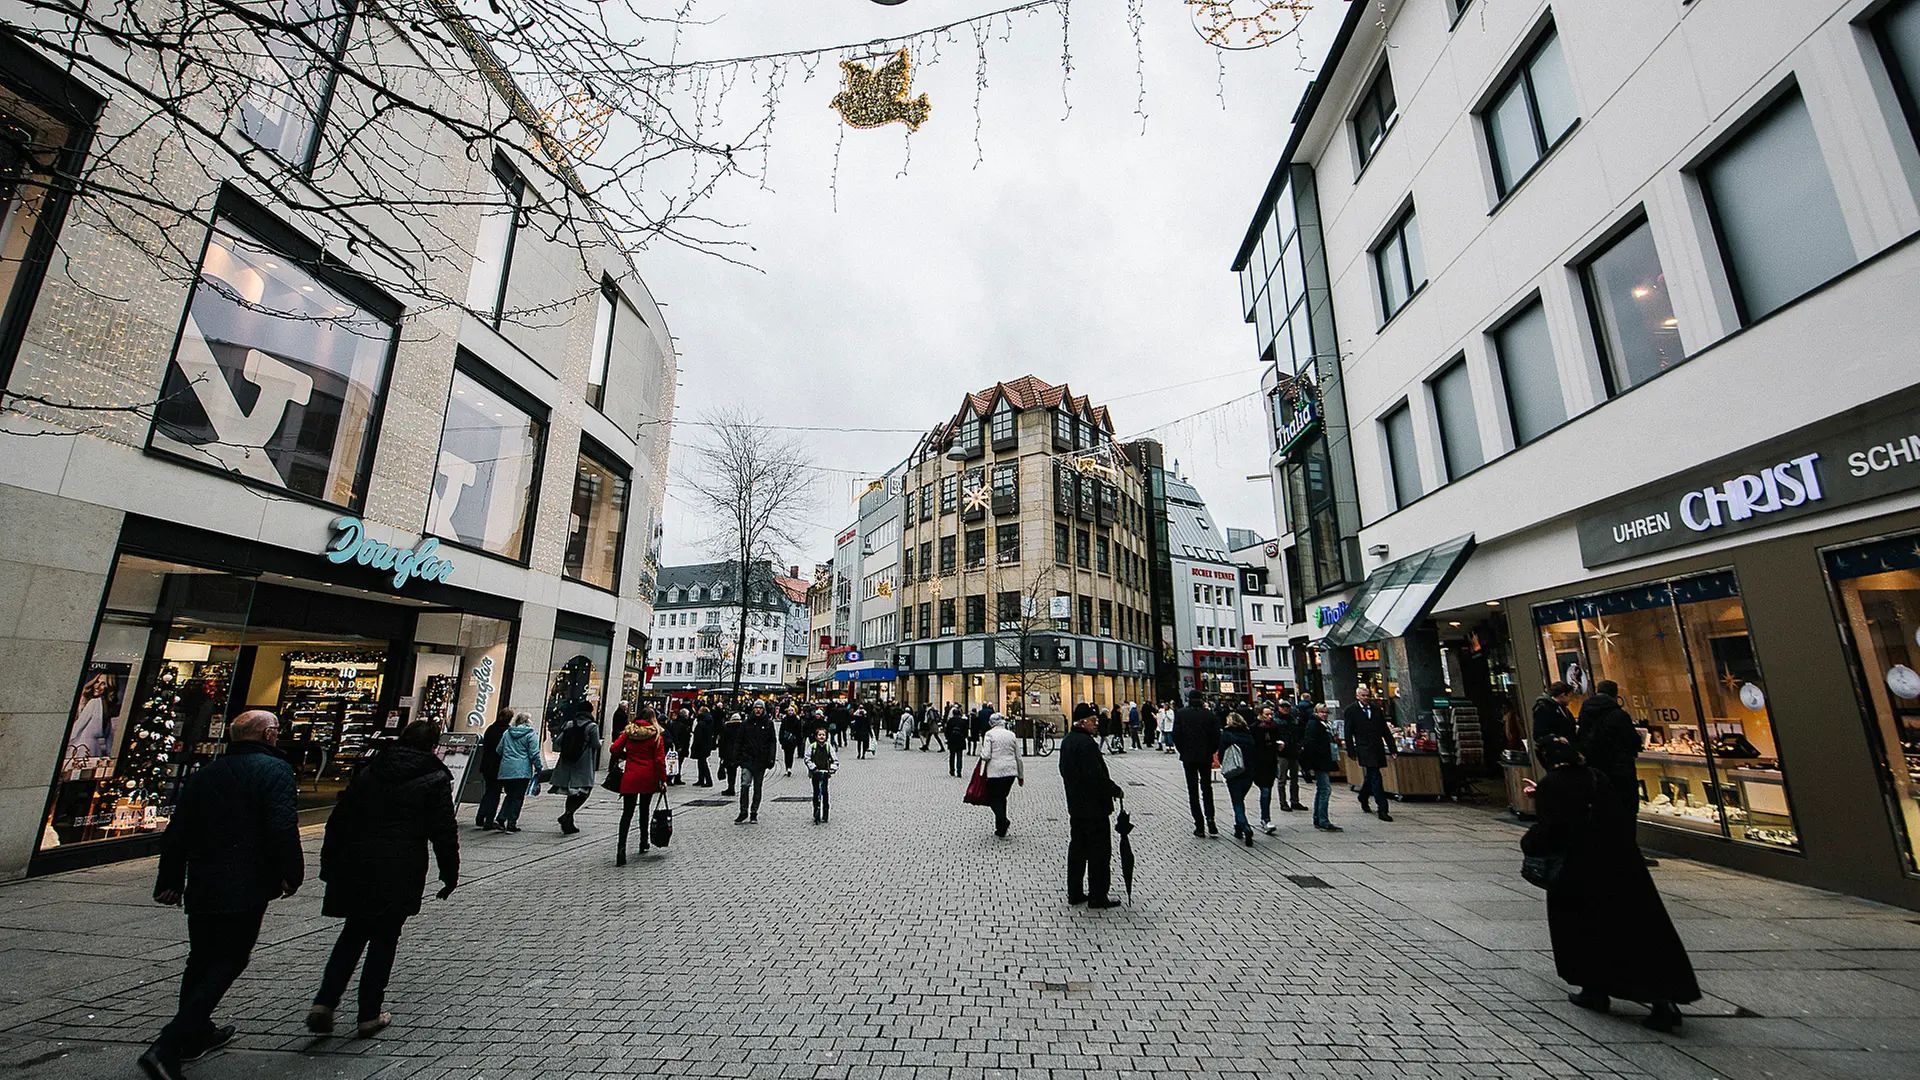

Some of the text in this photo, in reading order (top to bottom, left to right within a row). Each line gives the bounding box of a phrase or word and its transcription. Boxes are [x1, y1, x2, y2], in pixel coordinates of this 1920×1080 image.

[1276, 404, 1312, 450] Thalia
[1612, 511, 1672, 544] UHREN
[1679, 452, 1823, 532] CHRIST
[327, 516, 455, 589] Douglas
[305, 679, 379, 690] URBAN DECA
[466, 654, 495, 729] Douglas
